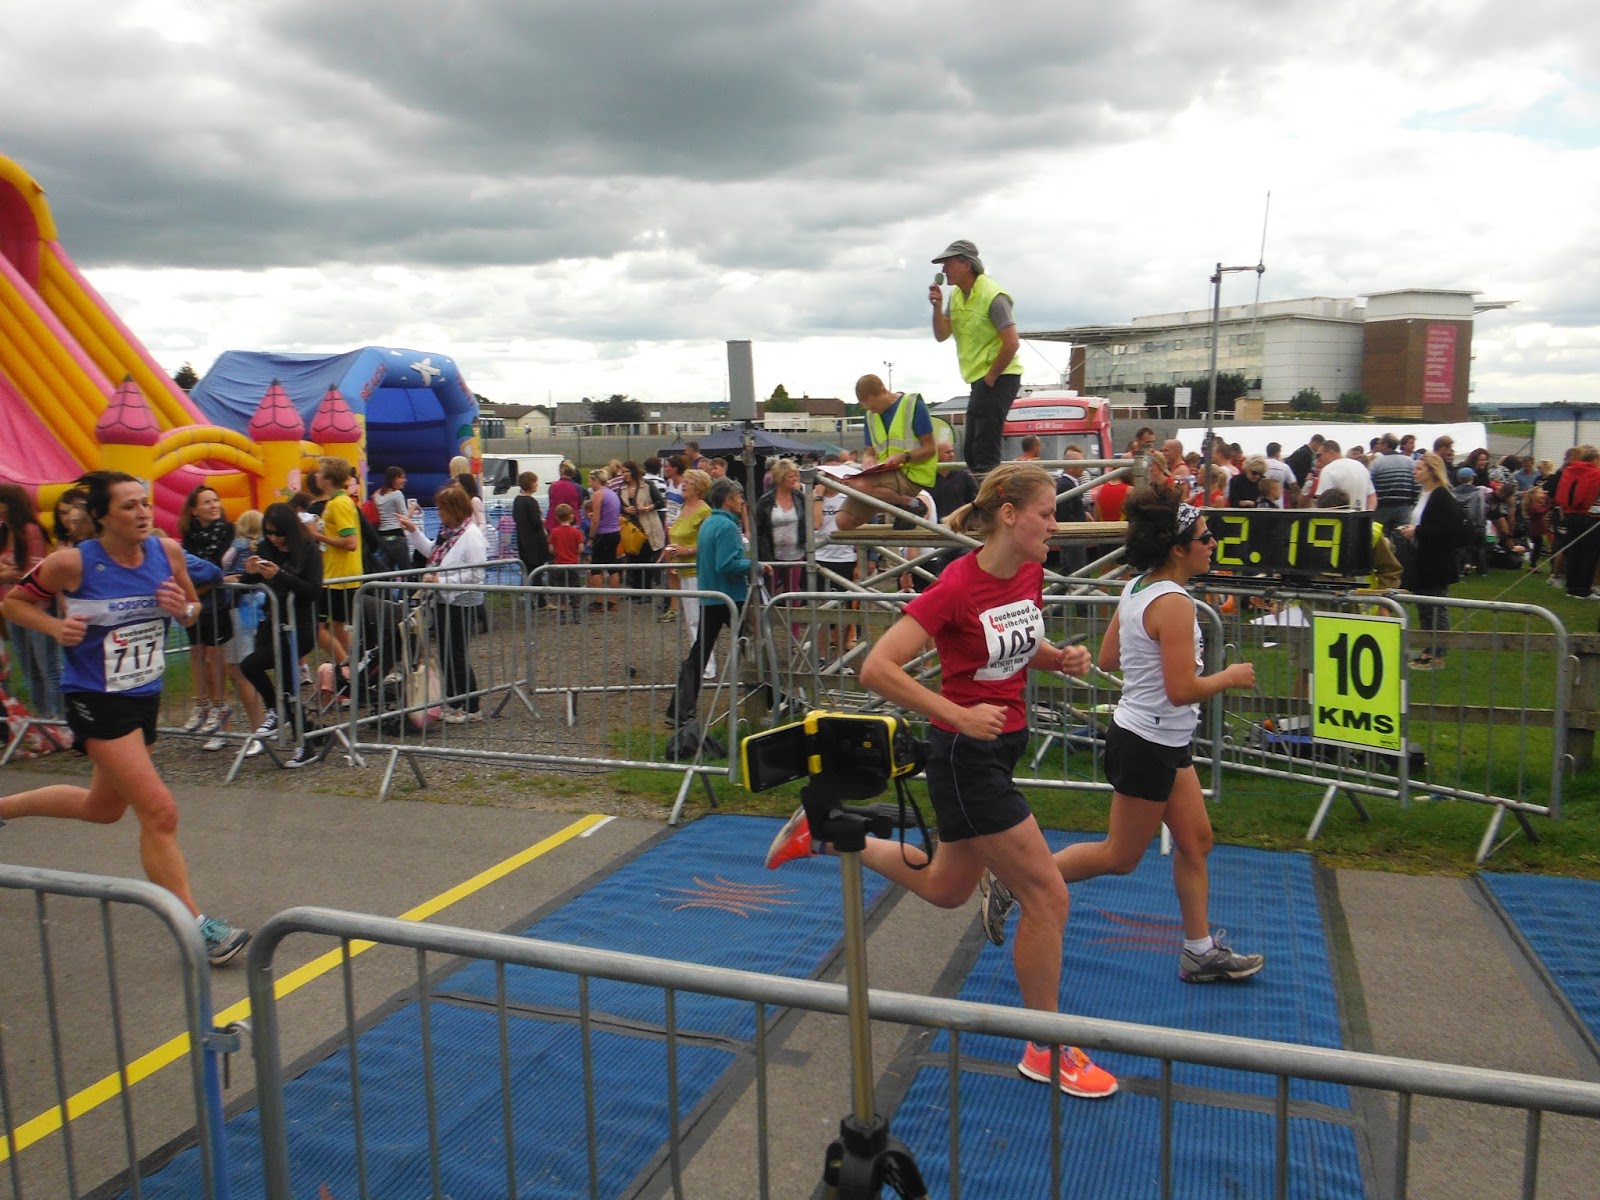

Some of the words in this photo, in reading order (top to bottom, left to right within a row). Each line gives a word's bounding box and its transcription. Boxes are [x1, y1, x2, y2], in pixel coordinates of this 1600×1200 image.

[1204, 515, 1342, 569] 2.19
[114, 641, 157, 674] 717
[998, 626, 1036, 661] 105
[1329, 633, 1384, 700] 10
[1318, 706, 1394, 735] KMS
